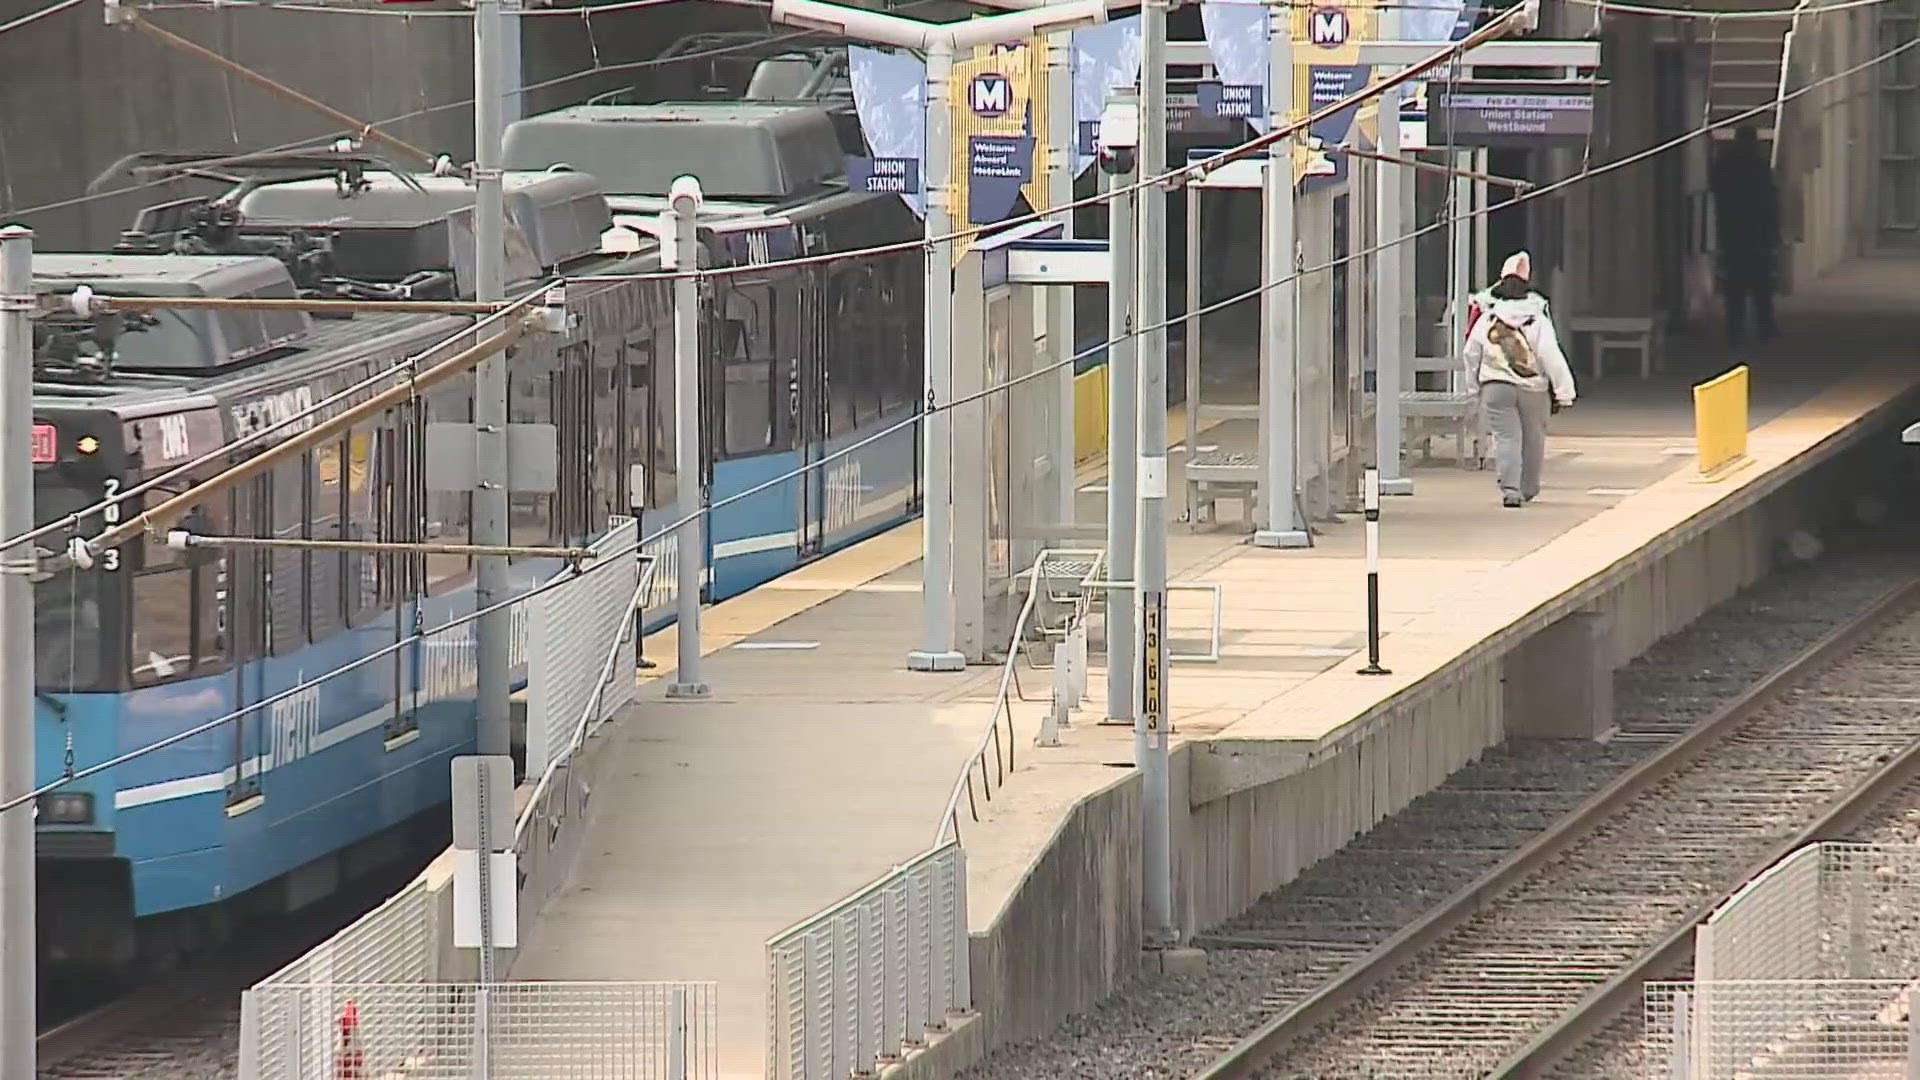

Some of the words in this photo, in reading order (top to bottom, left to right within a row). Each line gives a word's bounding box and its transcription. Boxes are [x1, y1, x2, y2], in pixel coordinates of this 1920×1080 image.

[1315, 14, 1342, 42] M
[1314, 72, 1352, 80] Welcome
[976, 81, 1005, 111] M
[1223, 87, 1251, 100] UNION
[1217, 103, 1252, 116] STATION
[1480, 109, 1511, 119] Union
[1514, 110, 1553, 120] Station
[1487, 122, 1546, 133] Westbound
[975, 142, 1016, 153] Welcome
[974, 154, 1007, 165] Aboard
[874, 160, 906, 174] UNION
[973, 166, 1022, 177] MetroLink
[866, 177, 906, 191] STATION
